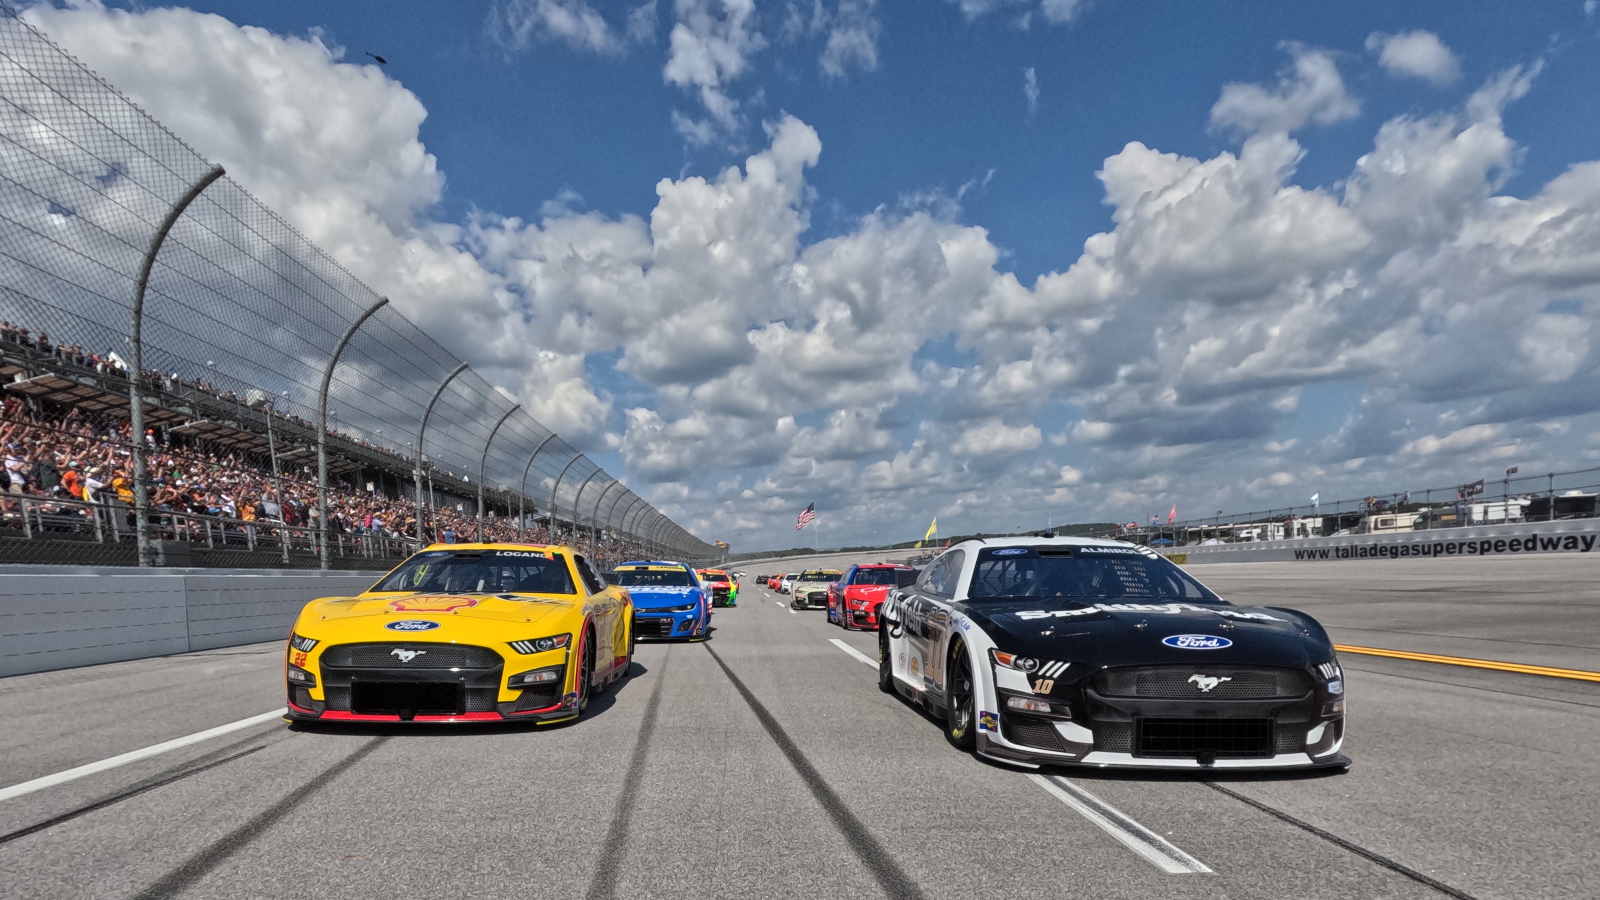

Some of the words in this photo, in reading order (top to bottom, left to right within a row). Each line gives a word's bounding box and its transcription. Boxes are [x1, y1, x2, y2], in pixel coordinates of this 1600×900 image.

[1080, 547, 1144, 555] ALMIROL
[394, 620, 431, 630] Ford
[1177, 635, 1220, 648] Ford
[294, 652, 308, 667] 22
[1032, 679, 1055, 694] 10
